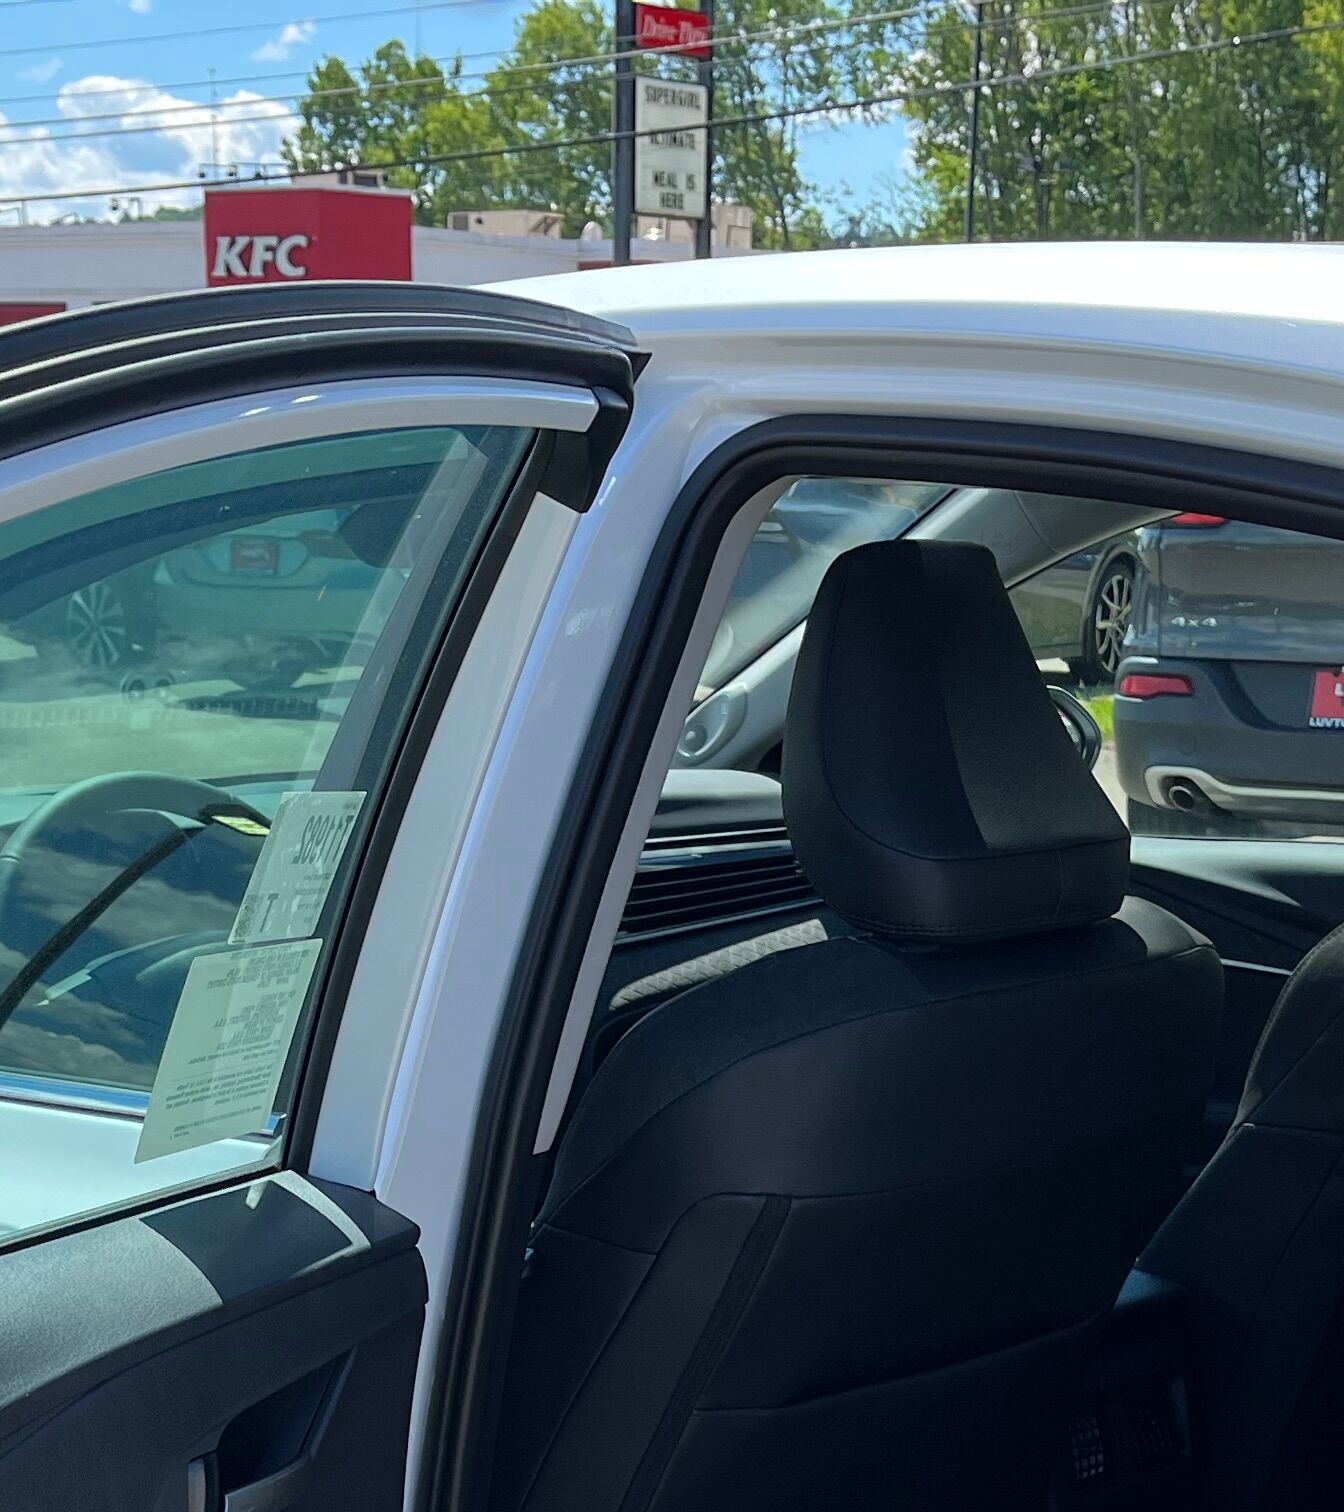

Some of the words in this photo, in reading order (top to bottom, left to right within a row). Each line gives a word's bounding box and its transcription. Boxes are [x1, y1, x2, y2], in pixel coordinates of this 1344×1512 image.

[652, 170, 677, 188] MEAL
[686, 173, 695, 190] IS
[660, 192, 685, 210] HERE
[211, 235, 309, 279] KFC
